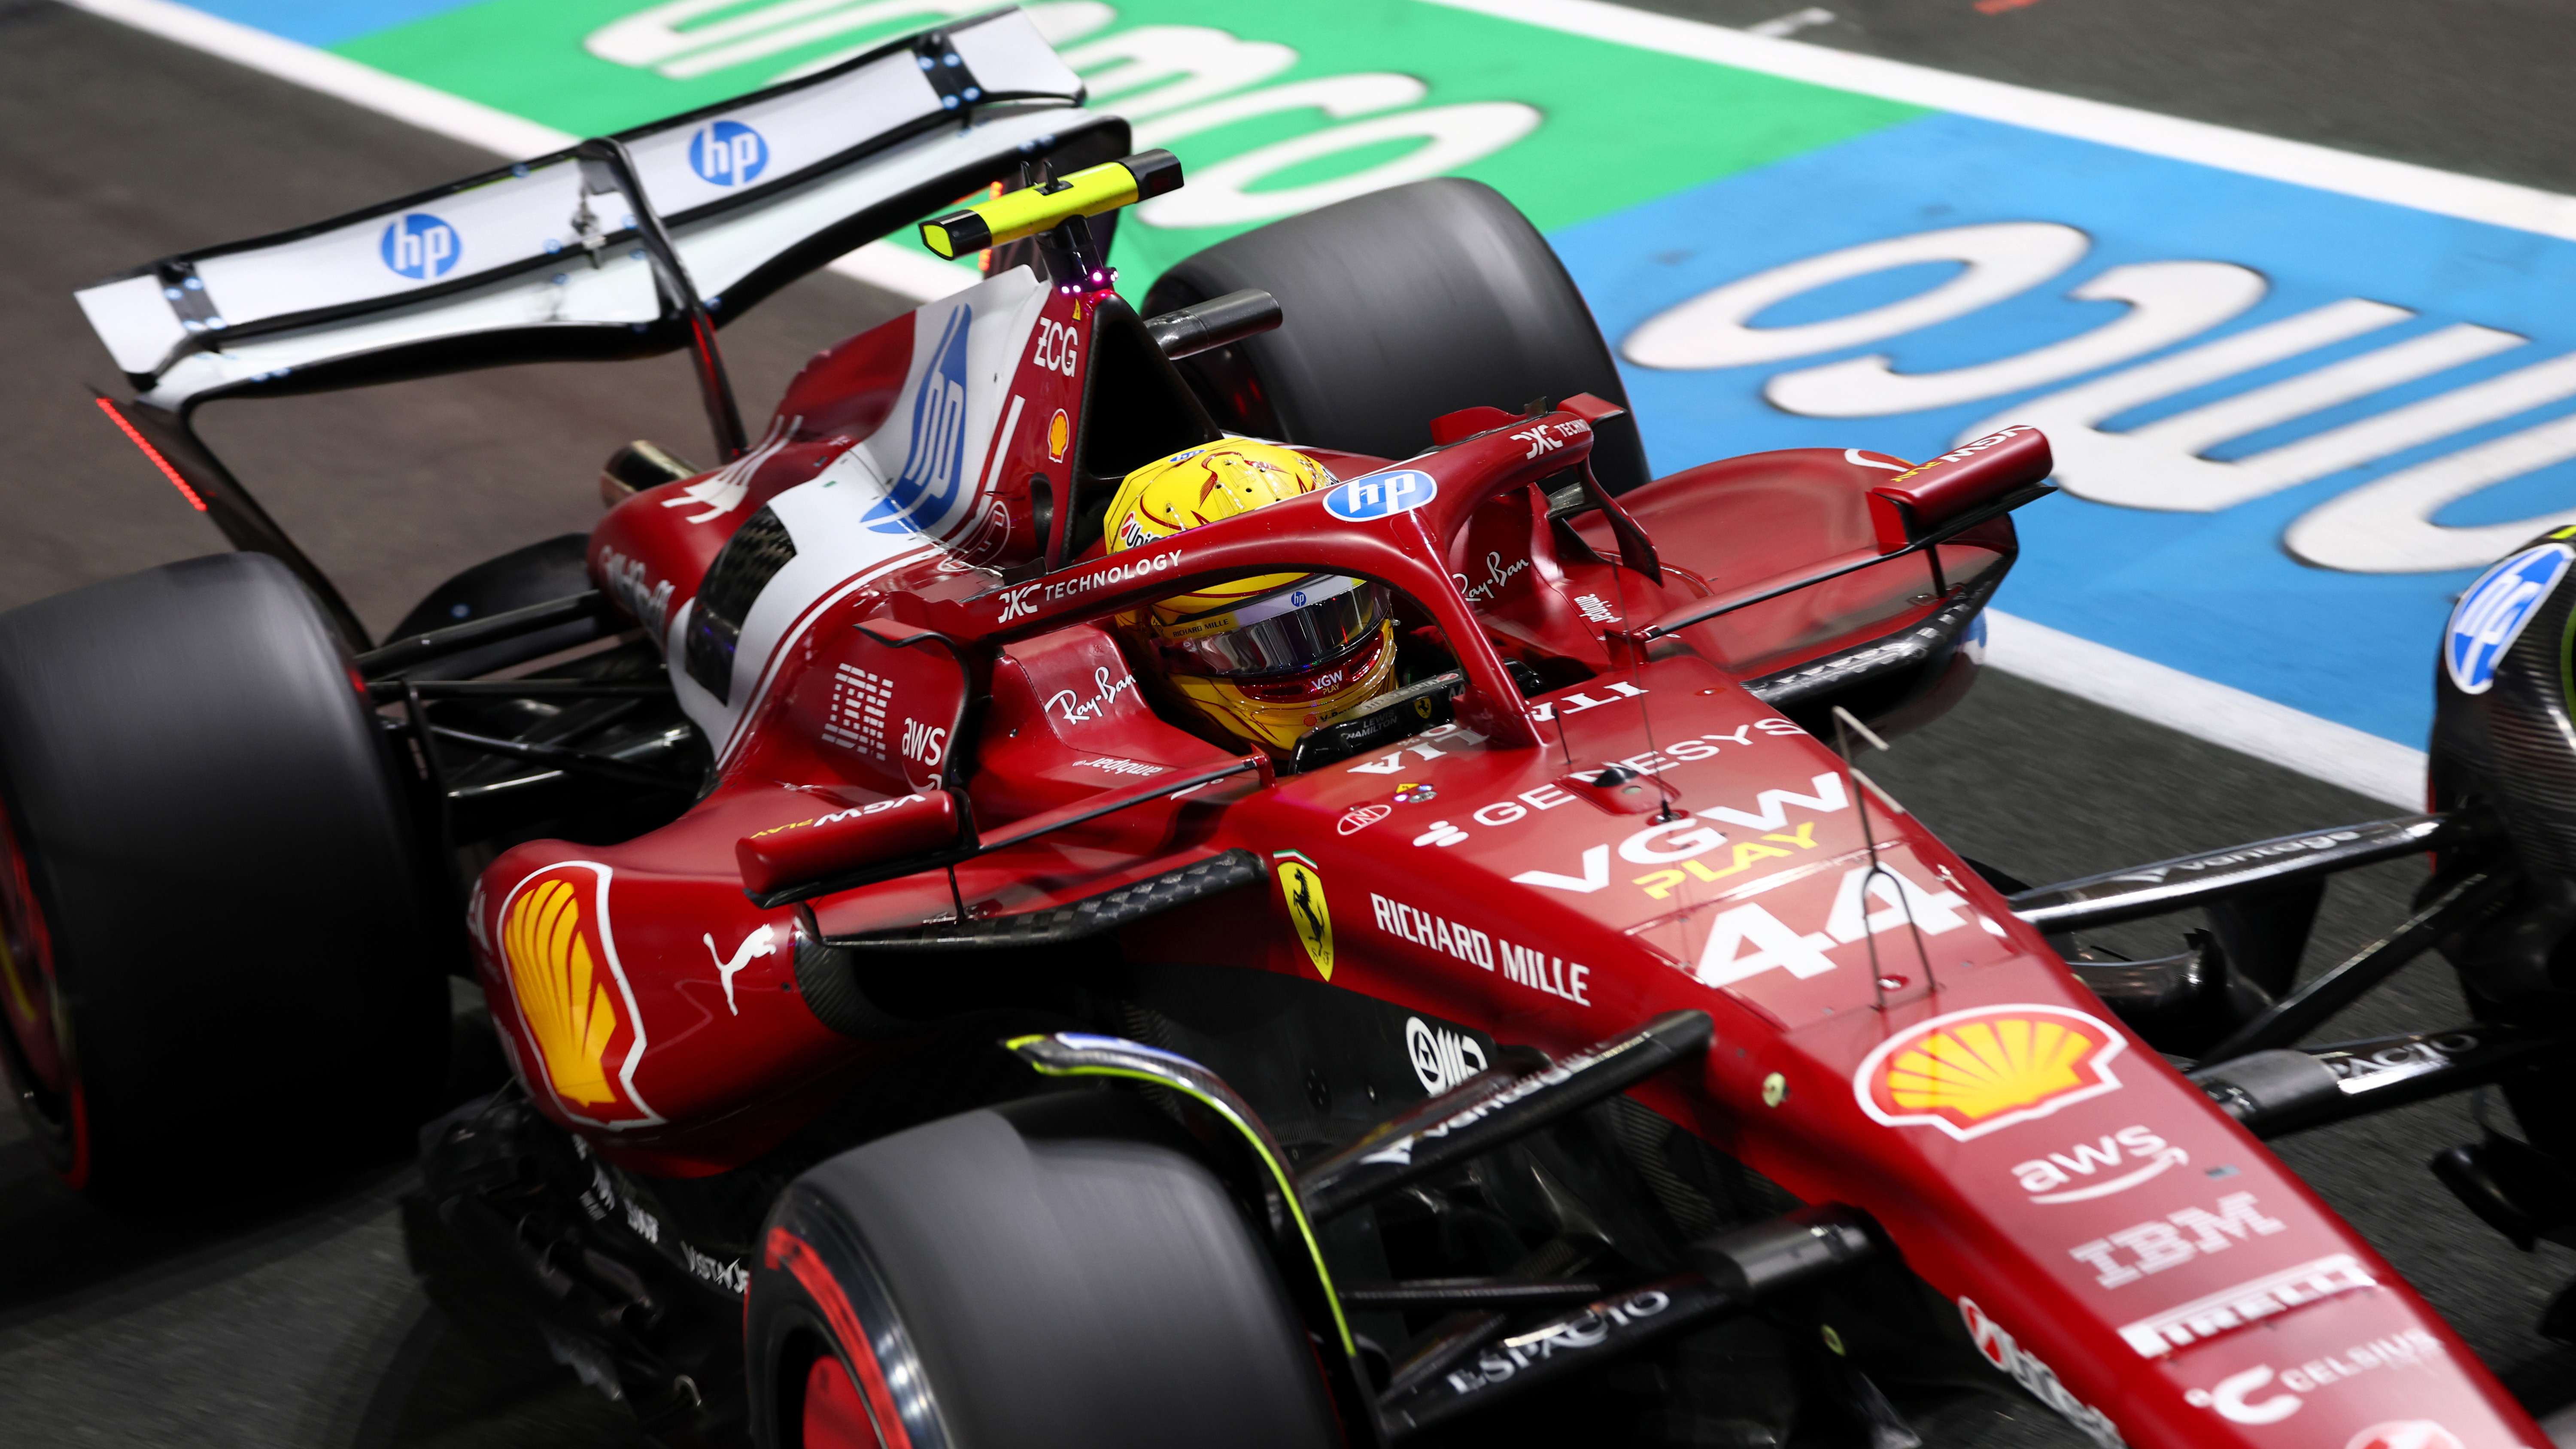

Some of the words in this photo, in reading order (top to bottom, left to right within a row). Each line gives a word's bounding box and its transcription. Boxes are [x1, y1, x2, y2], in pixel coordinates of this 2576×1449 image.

[702, 122, 758, 185] hp
[394, 216, 451, 278] hp
[1033, 317, 1078, 377] ZCG
[1939, 426, 2033, 462] VGW
[1346, 473, 1417, 513] hp
[998, 583, 1042, 624] DXC
[1045, 550, 1182, 601] TECHNOLOGY
[1292, 592, 1305, 607] hp
[1574, 593, 1614, 623] ambipar
[1173, 626, 1202, 637] RICHARD
[1205, 619, 1229, 629] MILLE
[1311, 670, 1343, 690] VGW
[1323, 683, 1340, 695] PLAY
[822, 663, 893, 761] IBM
[1346, 717, 1397, 740] HAMILTON
[1363, 710, 1394, 729] LEWIS
[902, 718, 945, 766] aws
[1084, 758, 1163, 776] ambipar
[813, 794, 926, 827] VGW
[1510, 772, 1849, 892] VGW
[1632, 822, 1818, 899] PLAY
[1696, 861, 1968, 989] 44
[1370, 892, 1494, 972] RICHARD
[1498, 939, 1591, 1007] MILLE
[2011, 1125, 2167, 1193] aws
[2069, 1191, 2287, 1289] IBM
